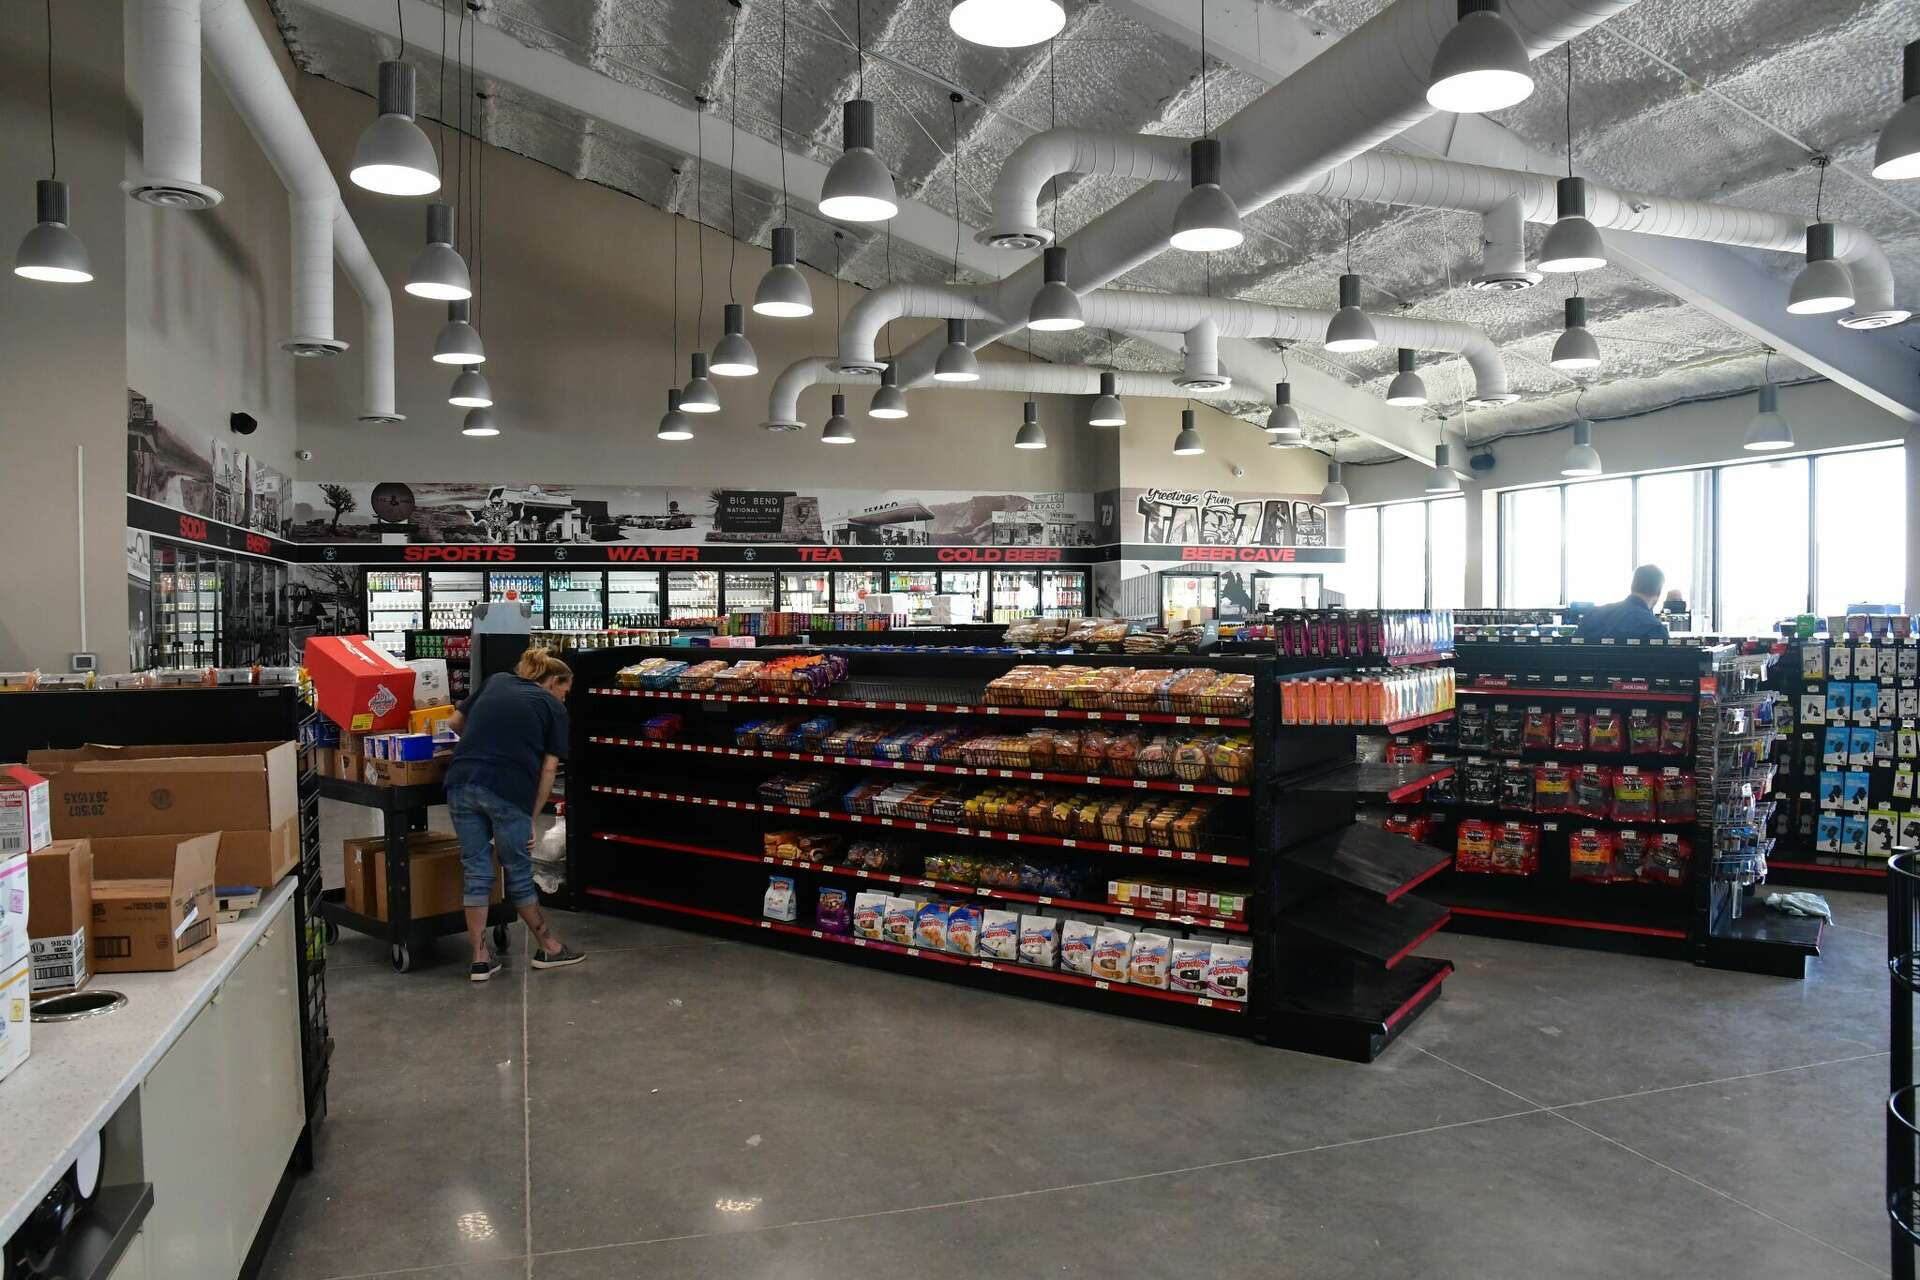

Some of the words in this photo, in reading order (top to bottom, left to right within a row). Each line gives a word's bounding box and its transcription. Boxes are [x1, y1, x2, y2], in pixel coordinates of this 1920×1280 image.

[729, 496, 746, 505] BIG
[753, 497, 778, 505] BEND
[1147, 488, 1199, 505] Greetings
[1204, 490, 1232, 504] From
[863, 501, 899, 513] TEXACO
[179, 515, 207, 541] SODA
[404, 546, 516, 561] SPORTS
[607, 546, 699, 561] WATER
[798, 547, 843, 562] TEA
[937, 547, 1002, 562] COLD
[1003, 547, 1061, 562] BEER
[1182, 547, 1237, 562] BEER
[1239, 547, 1295, 562] CAVE
